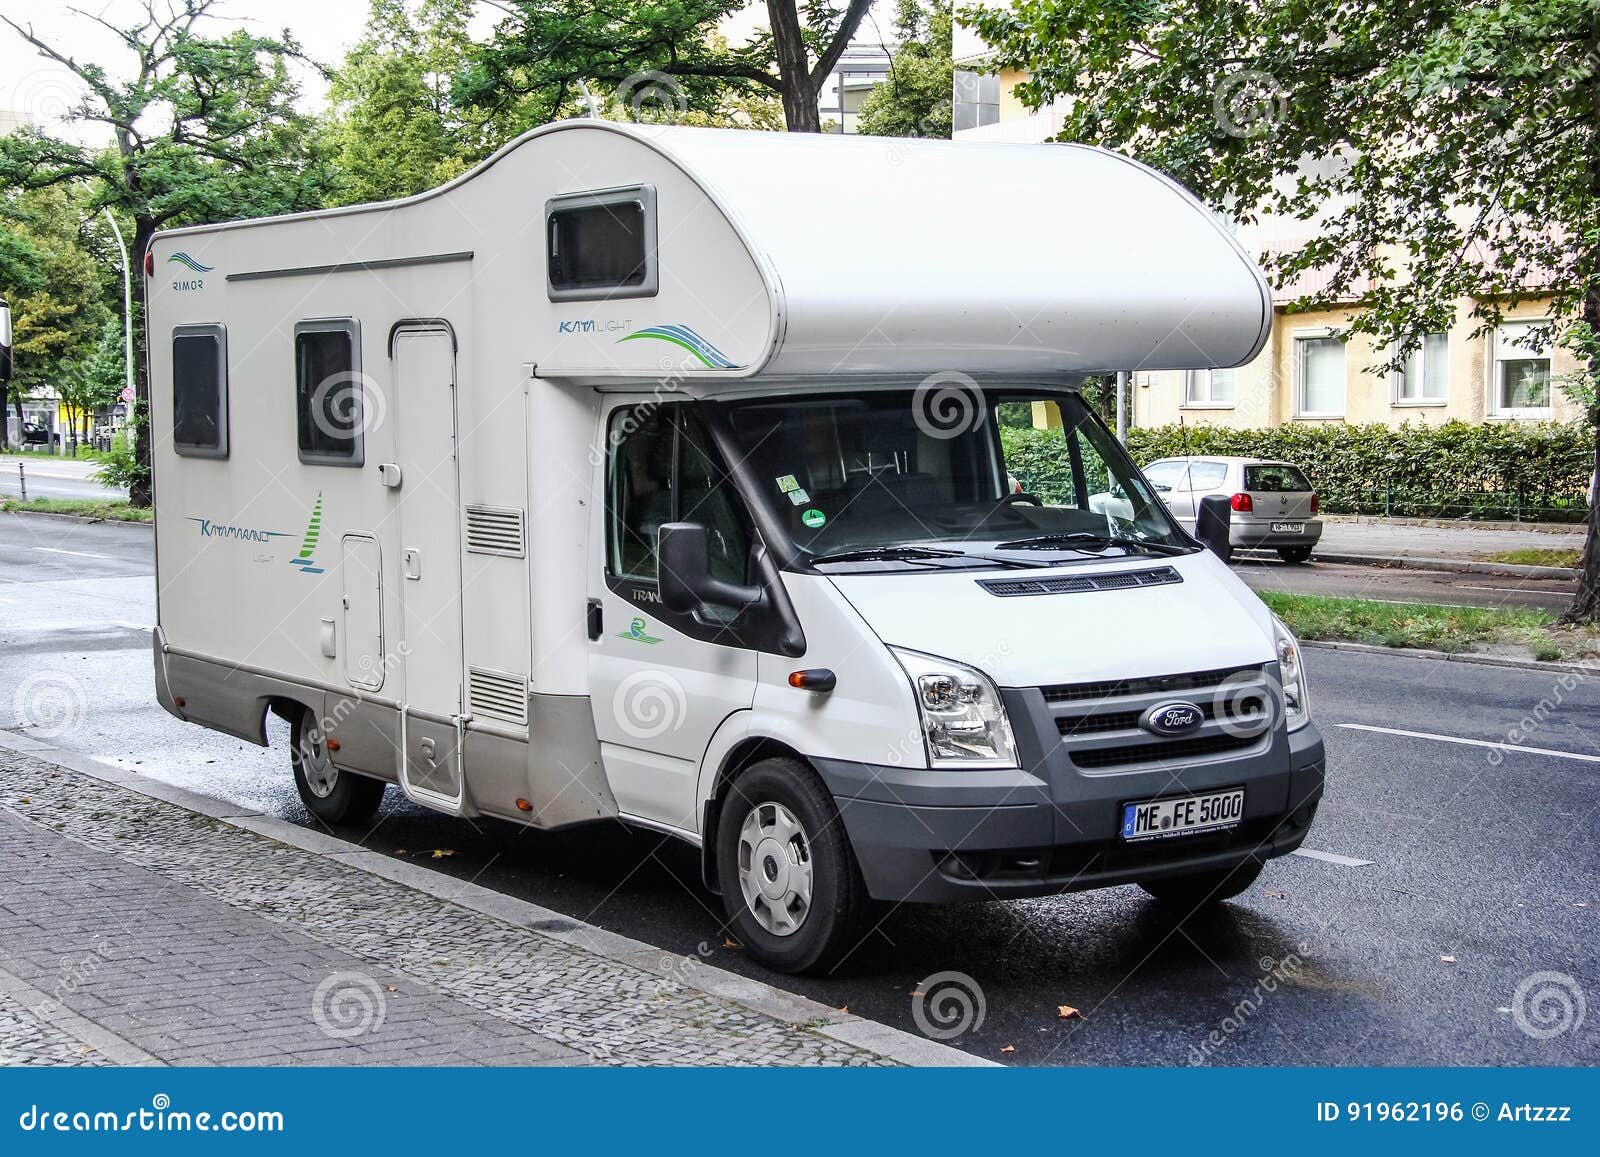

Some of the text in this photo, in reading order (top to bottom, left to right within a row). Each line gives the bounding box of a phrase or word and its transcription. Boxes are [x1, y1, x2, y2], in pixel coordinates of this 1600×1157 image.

[172, 279, 204, 291] RIMOR
[559, 319, 632, 333] KATA LIGHT
[631, 589, 664, 604] TRAN
[1164, 709, 1194, 727] Ford
[1136, 793, 1242, 833] ME FE 5000
